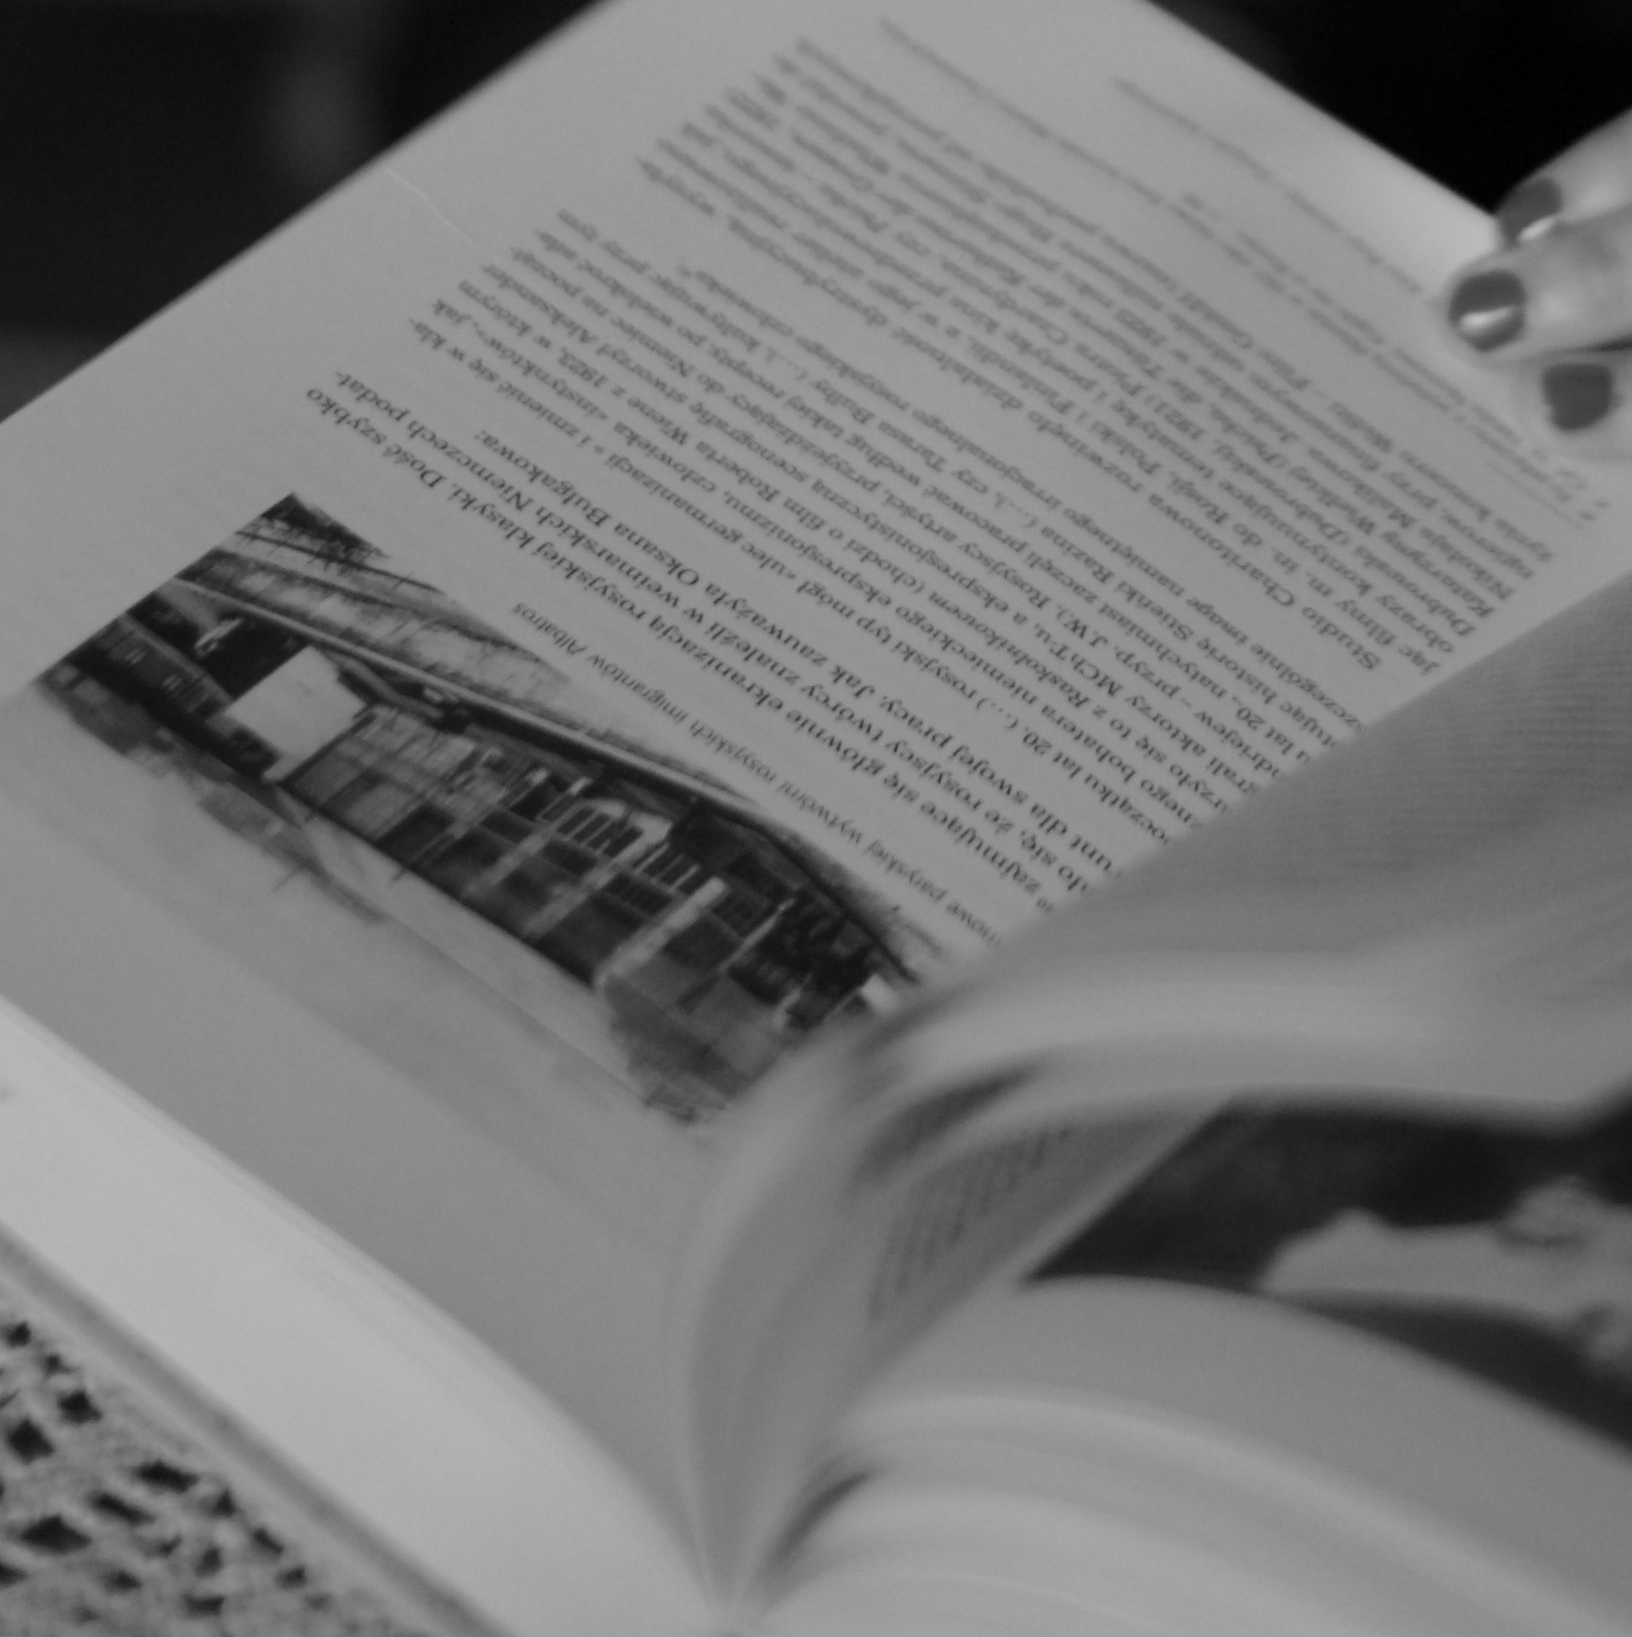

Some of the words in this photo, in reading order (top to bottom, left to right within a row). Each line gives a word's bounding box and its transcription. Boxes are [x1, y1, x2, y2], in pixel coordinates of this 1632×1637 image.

[432, 297, 471, 325] jak
[458, 279, 531, 337] którym
[482, 264, 596, 344] Aleksander
[467, 358, 500, 383] się
[595, 343, 687, 403] stworzył
[610, 317, 694, 378] Niemiec
[891, 327, 1022, 410] działalność
[305, 388, 386, 445] szybko
[335, 371, 410, 422] podat-
[496, 381, 580, 437] zmienić
[626, 397, 688, 446] Wiene
[382, 444, 446, 489] Dość
[407, 419, 531, 511] Niemczech
[613, 421, 716, 492] człowieka
[689, 401, 808, 482] scenografię
[695, 440, 779, 502] Roberta
[845, 433, 920, 486] według
[1027, 411, 1142, 492] rozwinęło
[1090, 420, 1161, 475] Polski
[474, 430, 610, 527] Bułgakowa:
[604, 453, 743, 543] germanizacji
[950, 468, 988, 494] czy
[447, 483, 535, 549] klasyki.
[782, 497, 825, 530] film
[922, 485, 1027, 553] pracować
[535, 506, 679, 607] weimarskich
[613, 522, 700, 586] Oksana
[724, 491, 891, 606] ekspresjonizmu,
[811, 479, 1008, 612] ekspresjonistyczną
[957, 542, 1050, 609] Rosyjscy
[1040, 525, 1114, 584] Razina
[1148, 493, 1295, 607] Charitonowa
[531, 541, 646, 620] rosyjskiej
[795, 580, 855, 619] mógł
[1026, 550, 1098, 604] zaczęli
[511, 602, 587, 655] Albatros
[704, 582, 828, 666] zauważyła
[855, 616, 892, 645] typ
[1117, 580, 1194, 641] Stieńki
[1185, 596, 1248, 645] image
[1301, 606, 1380, 670] Studio
[1336, 599, 1395, 645] filmy
[1375, 594, 1453, 653] obrazy
[648, 615, 783, 711] ekranizacją
[705, 622, 800, 684] znaleźli
[891, 640, 977, 699] rosyjski
[895, 606, 1037, 705] niemieckiego
[928, 591, 1089, 708] Raskolnikowem
[1098, 603, 1226, 698] natychmiast
[1196, 637, 1277, 705] historię
[1397, 646, 1440, 676] jąc
[586, 654, 688, 724] imigrantów
[830, 664, 875, 699] Jak
[800, 684, 883, 742] twórcy
[878, 695, 953, 748] pracy.
[1021, 726, 1052, 756] 20.
[1125, 695, 1206, 756] aktorzy
[1264, 727, 1294, 755] lat
[785, 711, 885, 776] głównie
[1040, 704, 1136, 783] bohatera
[1051, 753, 1082, 779] lat
[1134, 735, 1167, 763] się
[882, 772, 919, 803] się
[884, 740, 982, 810] rosyjscy
[948, 744, 1028, 804] swojej
[920, 803, 1040, 894] zajmujące
[1020, 829, 1057, 866] się,
[1029, 802, 1068, 835] dla
